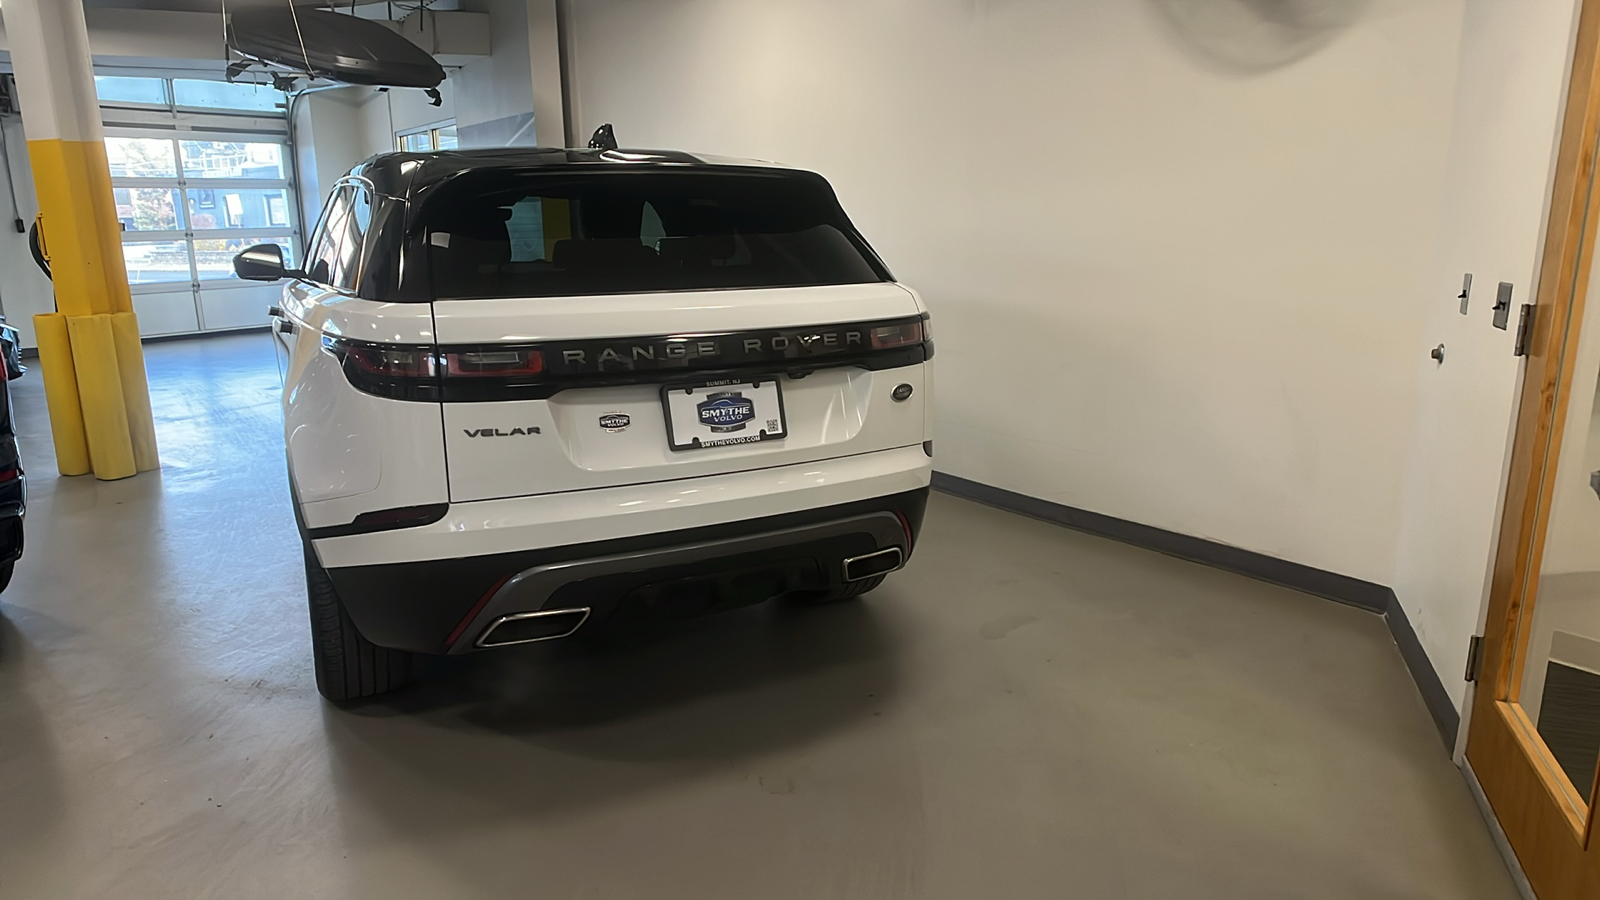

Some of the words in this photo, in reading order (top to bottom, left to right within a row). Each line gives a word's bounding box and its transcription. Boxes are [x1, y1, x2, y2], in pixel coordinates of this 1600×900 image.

[562, 341, 715, 365] RANGE
[743, 331, 862, 354] ROVER
[701, 406, 750, 418] SMYTHE
[713, 414, 743, 422] VOLVO
[463, 426, 541, 438] VELAR
[701, 435, 761, 448] SMYTHEVOLVO.COM
